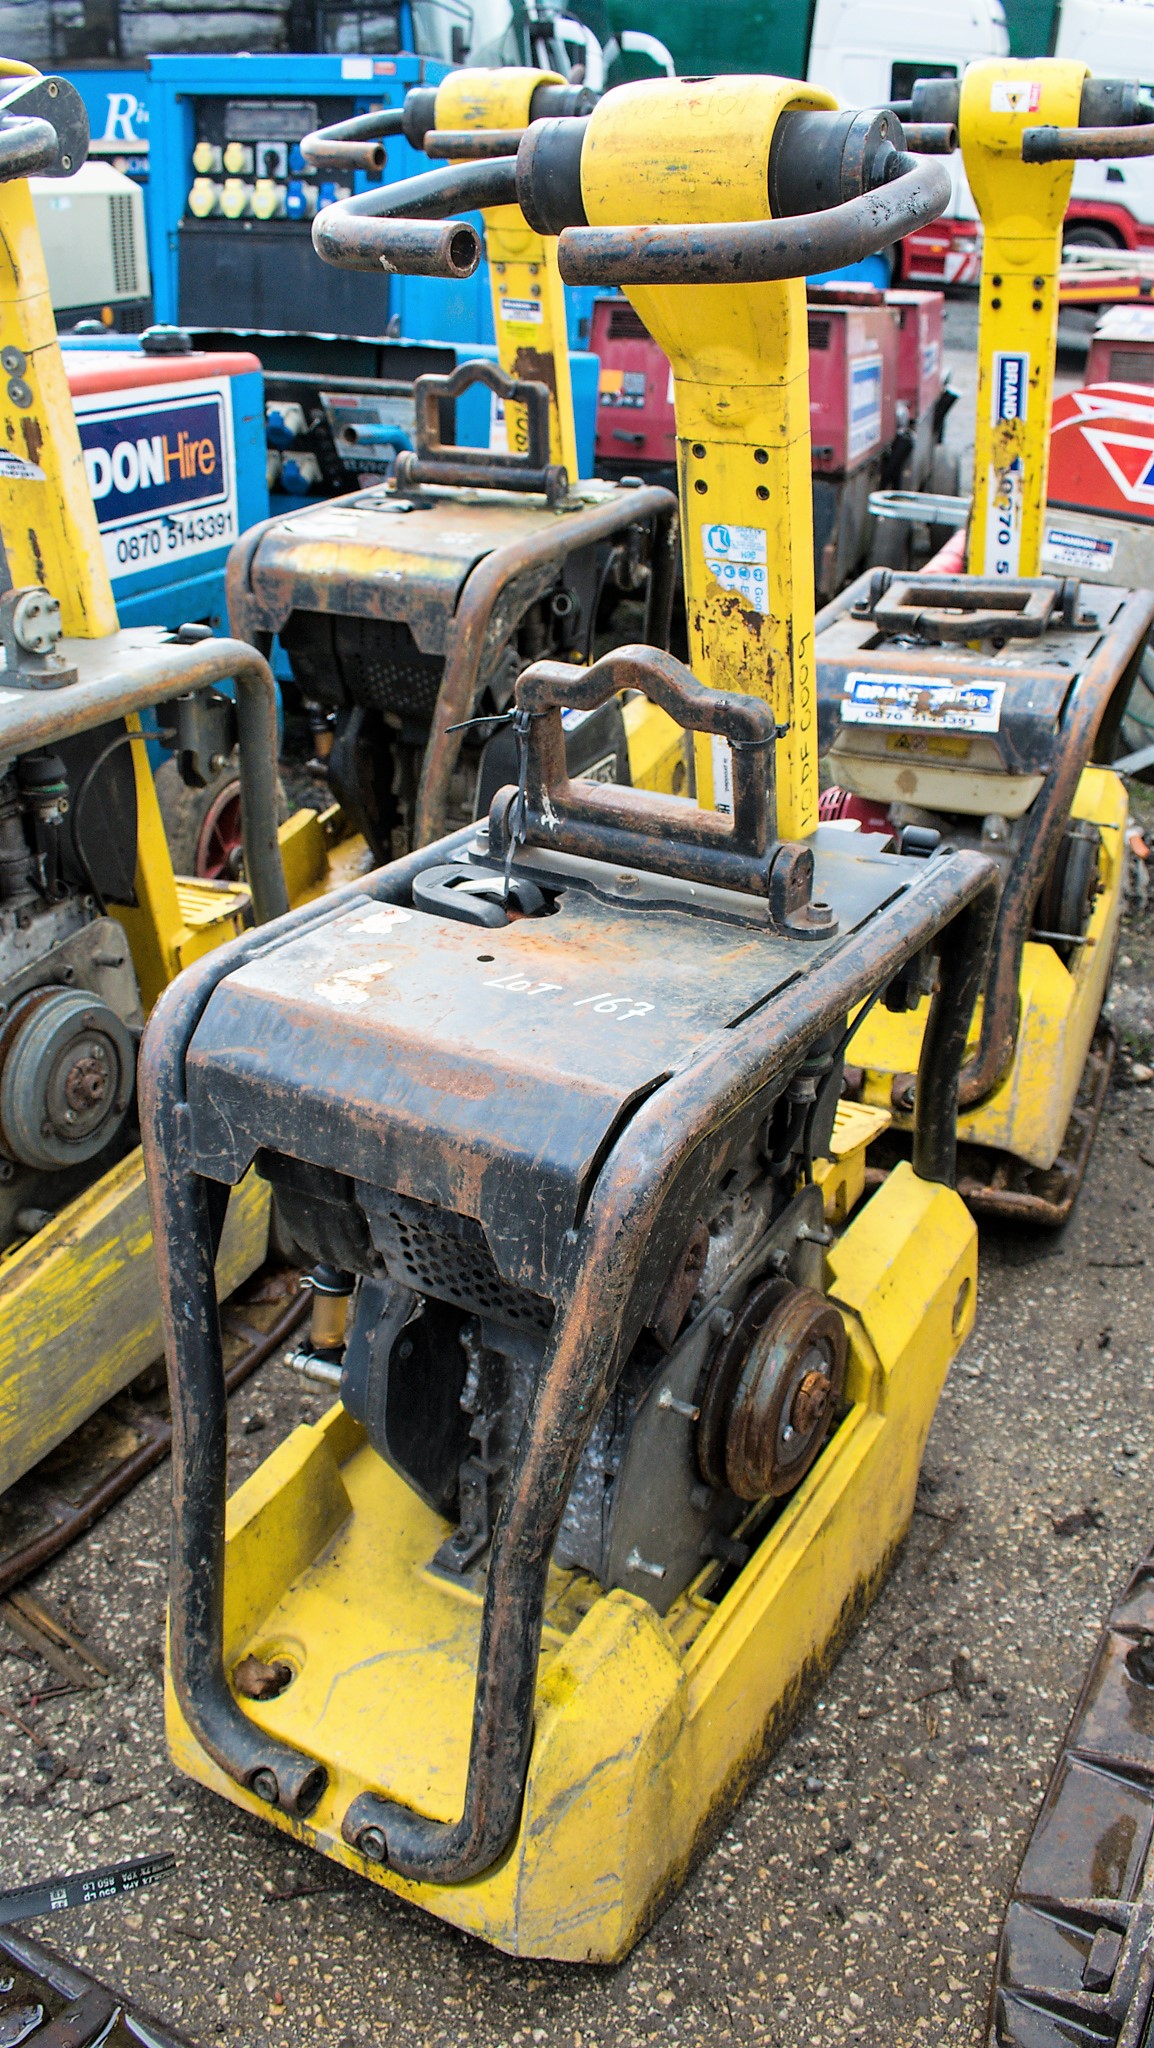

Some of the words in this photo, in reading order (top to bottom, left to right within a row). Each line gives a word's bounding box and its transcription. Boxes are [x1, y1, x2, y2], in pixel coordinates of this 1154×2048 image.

[117, 530, 161, 563] 0870
[168, 511, 233, 550] 5143391
[482, 973, 563, 995] LOT
[573, 993, 655, 1021] 167
